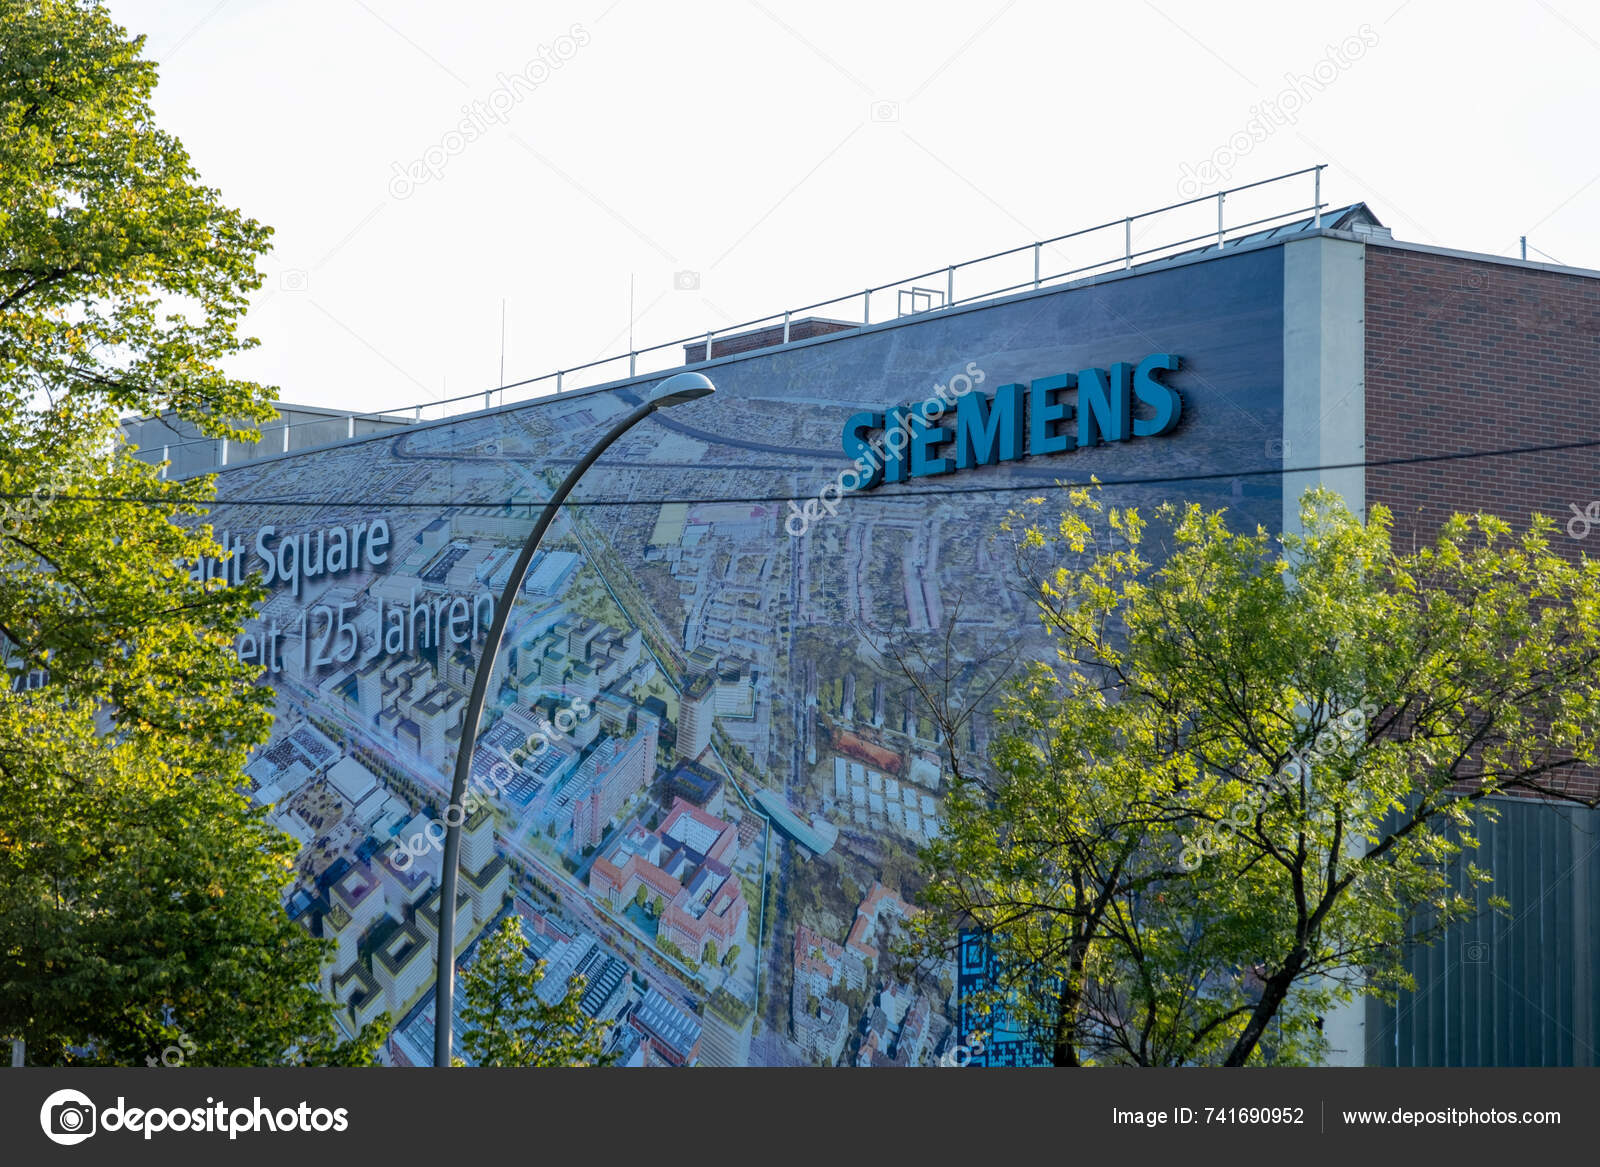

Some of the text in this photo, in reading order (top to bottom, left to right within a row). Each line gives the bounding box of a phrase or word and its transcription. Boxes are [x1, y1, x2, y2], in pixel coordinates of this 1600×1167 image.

[842, 353, 1182, 490] SIEMENS
[256, 519, 391, 596] Square
[237, 611, 281, 673] eit
[363, 586, 495, 664] Jahren
